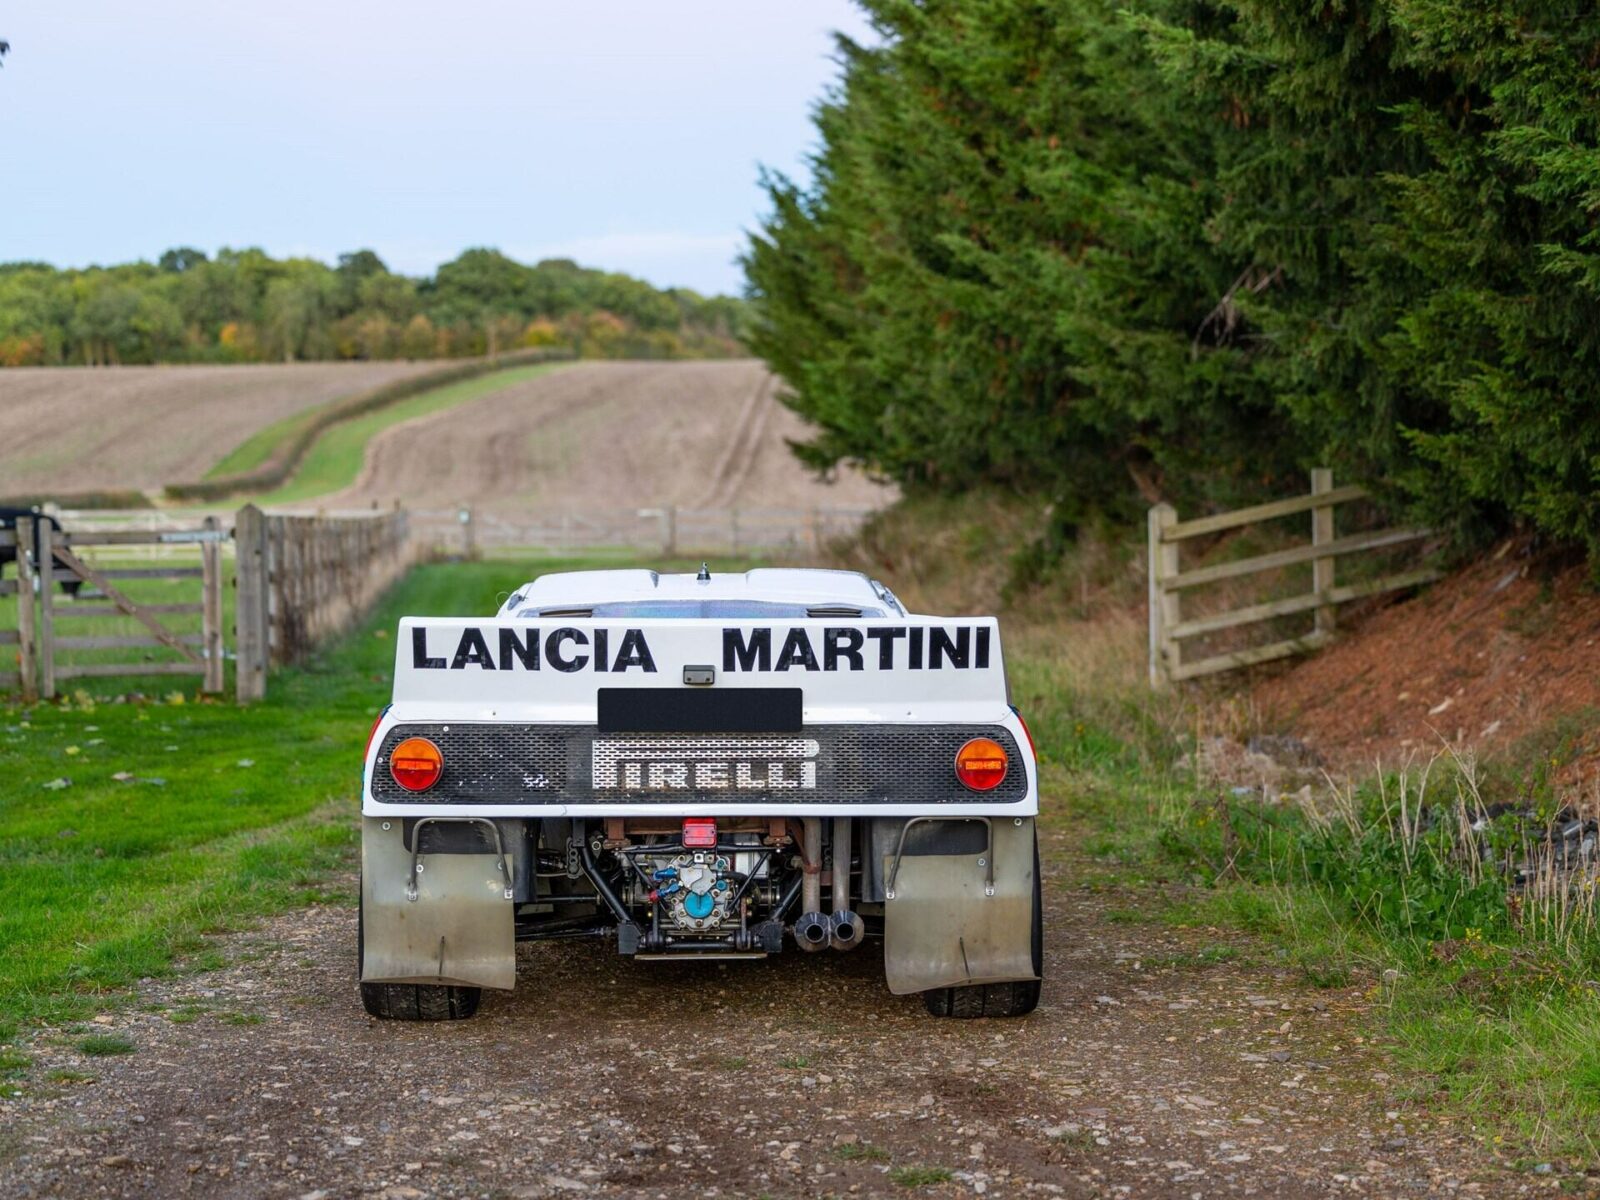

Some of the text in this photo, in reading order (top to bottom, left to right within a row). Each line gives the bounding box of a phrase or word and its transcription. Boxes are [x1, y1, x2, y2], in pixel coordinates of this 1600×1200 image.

[412, 626, 990, 673] LANCIA MARTINI
[592, 739, 820, 789] PIRELLI
